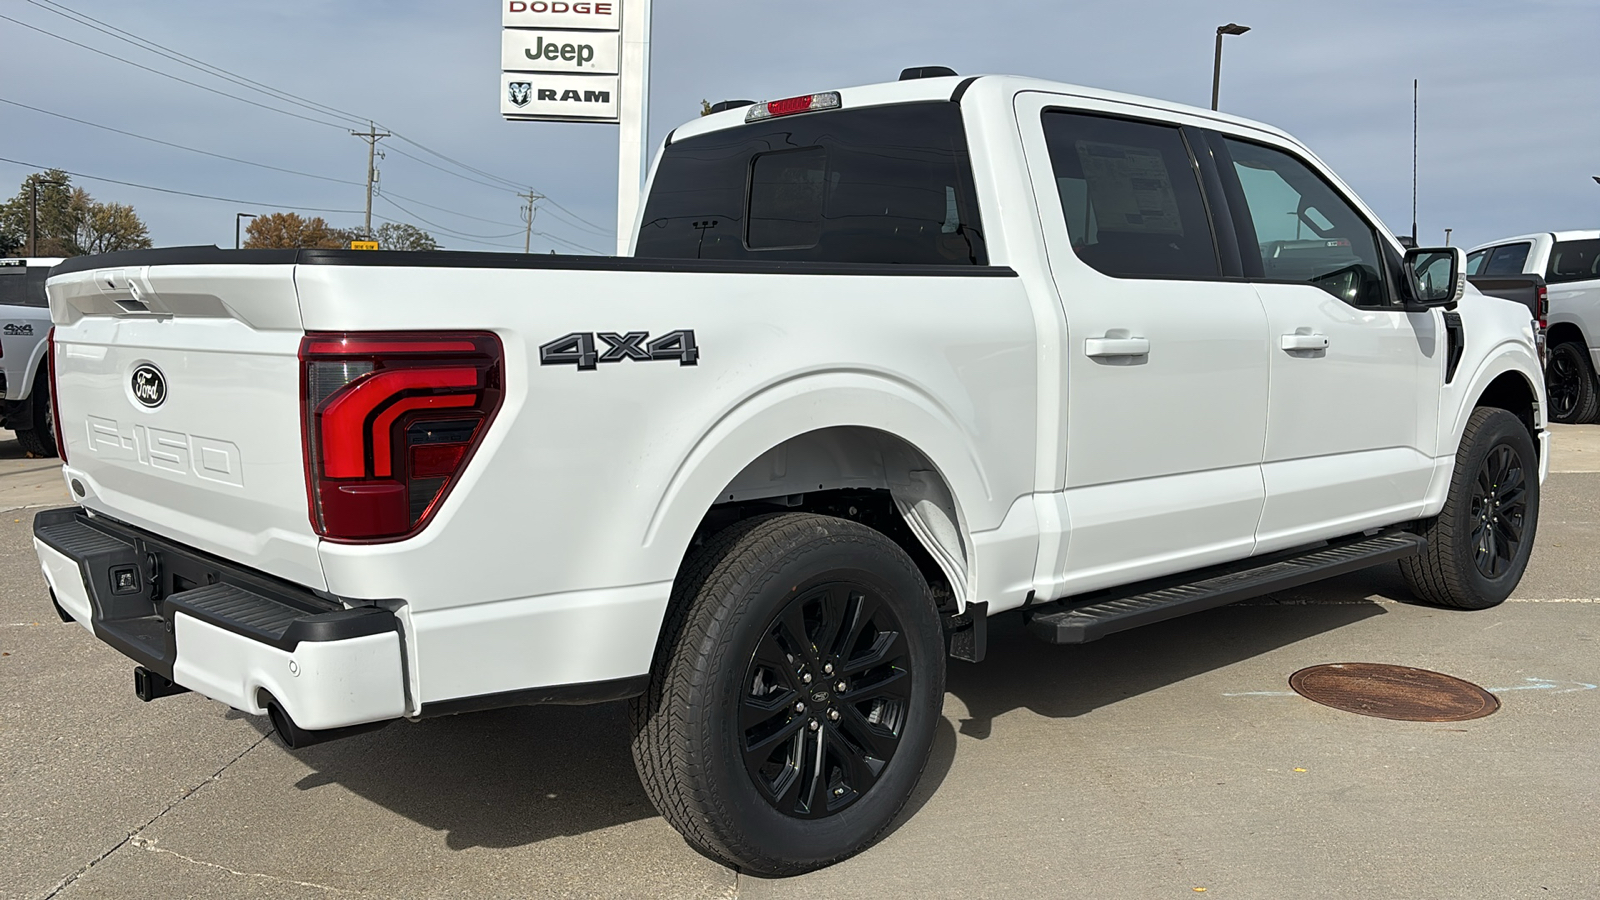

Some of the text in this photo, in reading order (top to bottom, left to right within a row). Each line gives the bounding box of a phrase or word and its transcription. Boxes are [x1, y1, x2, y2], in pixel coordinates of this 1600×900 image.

[509, 1, 612, 15] DODGE
[525, 36, 594, 67] Jeep
[537, 88, 610, 103] RAM
[134, 370, 159, 400] Ford
[85, 414, 244, 488] F-150
